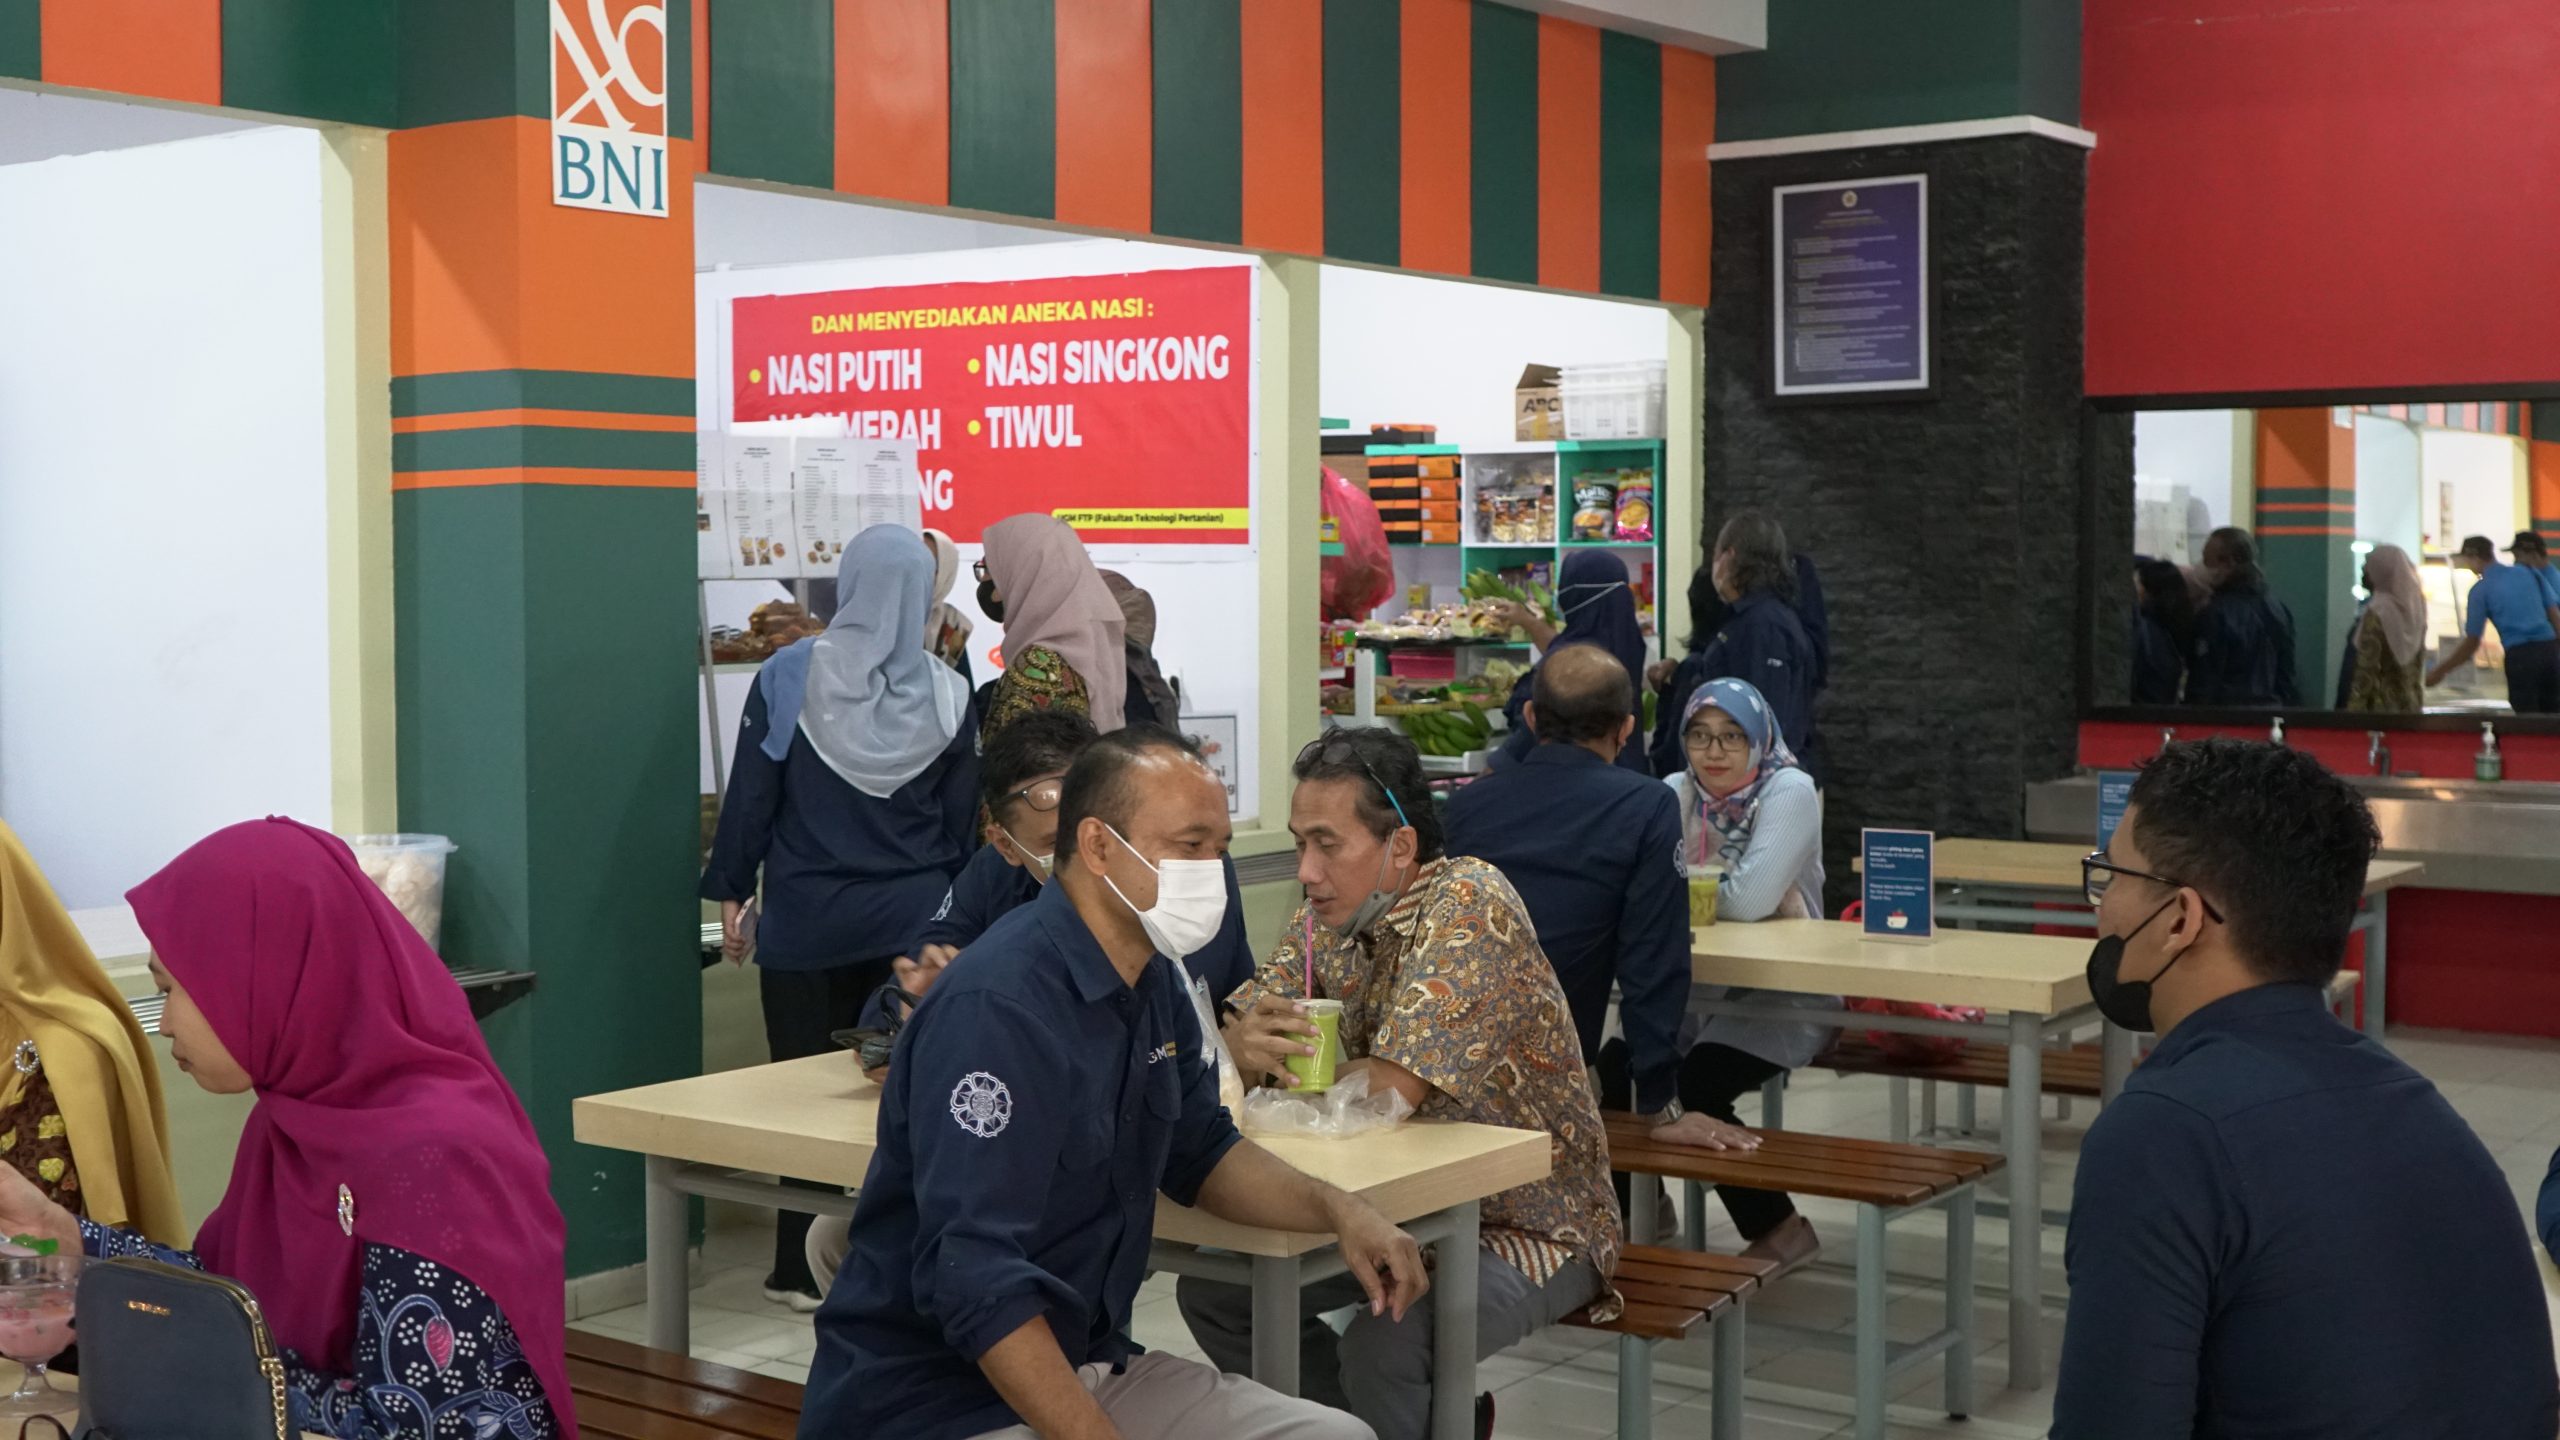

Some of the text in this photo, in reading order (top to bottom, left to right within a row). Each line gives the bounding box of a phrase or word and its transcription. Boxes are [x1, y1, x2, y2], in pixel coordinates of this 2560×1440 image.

[557, 134, 665, 211] BNI
[811, 314, 854, 335] DAN
[857, 305, 1007, 331] MENYEDIAKAN
[1010, 301, 1087, 324] ANEKA
[1090, 297, 1144, 320] NASI
[767, 348, 922, 396] NASI PUTIH
[985, 334, 1229, 387] NASI SINGKONG
[984, 404, 1082, 449] TIWUL
